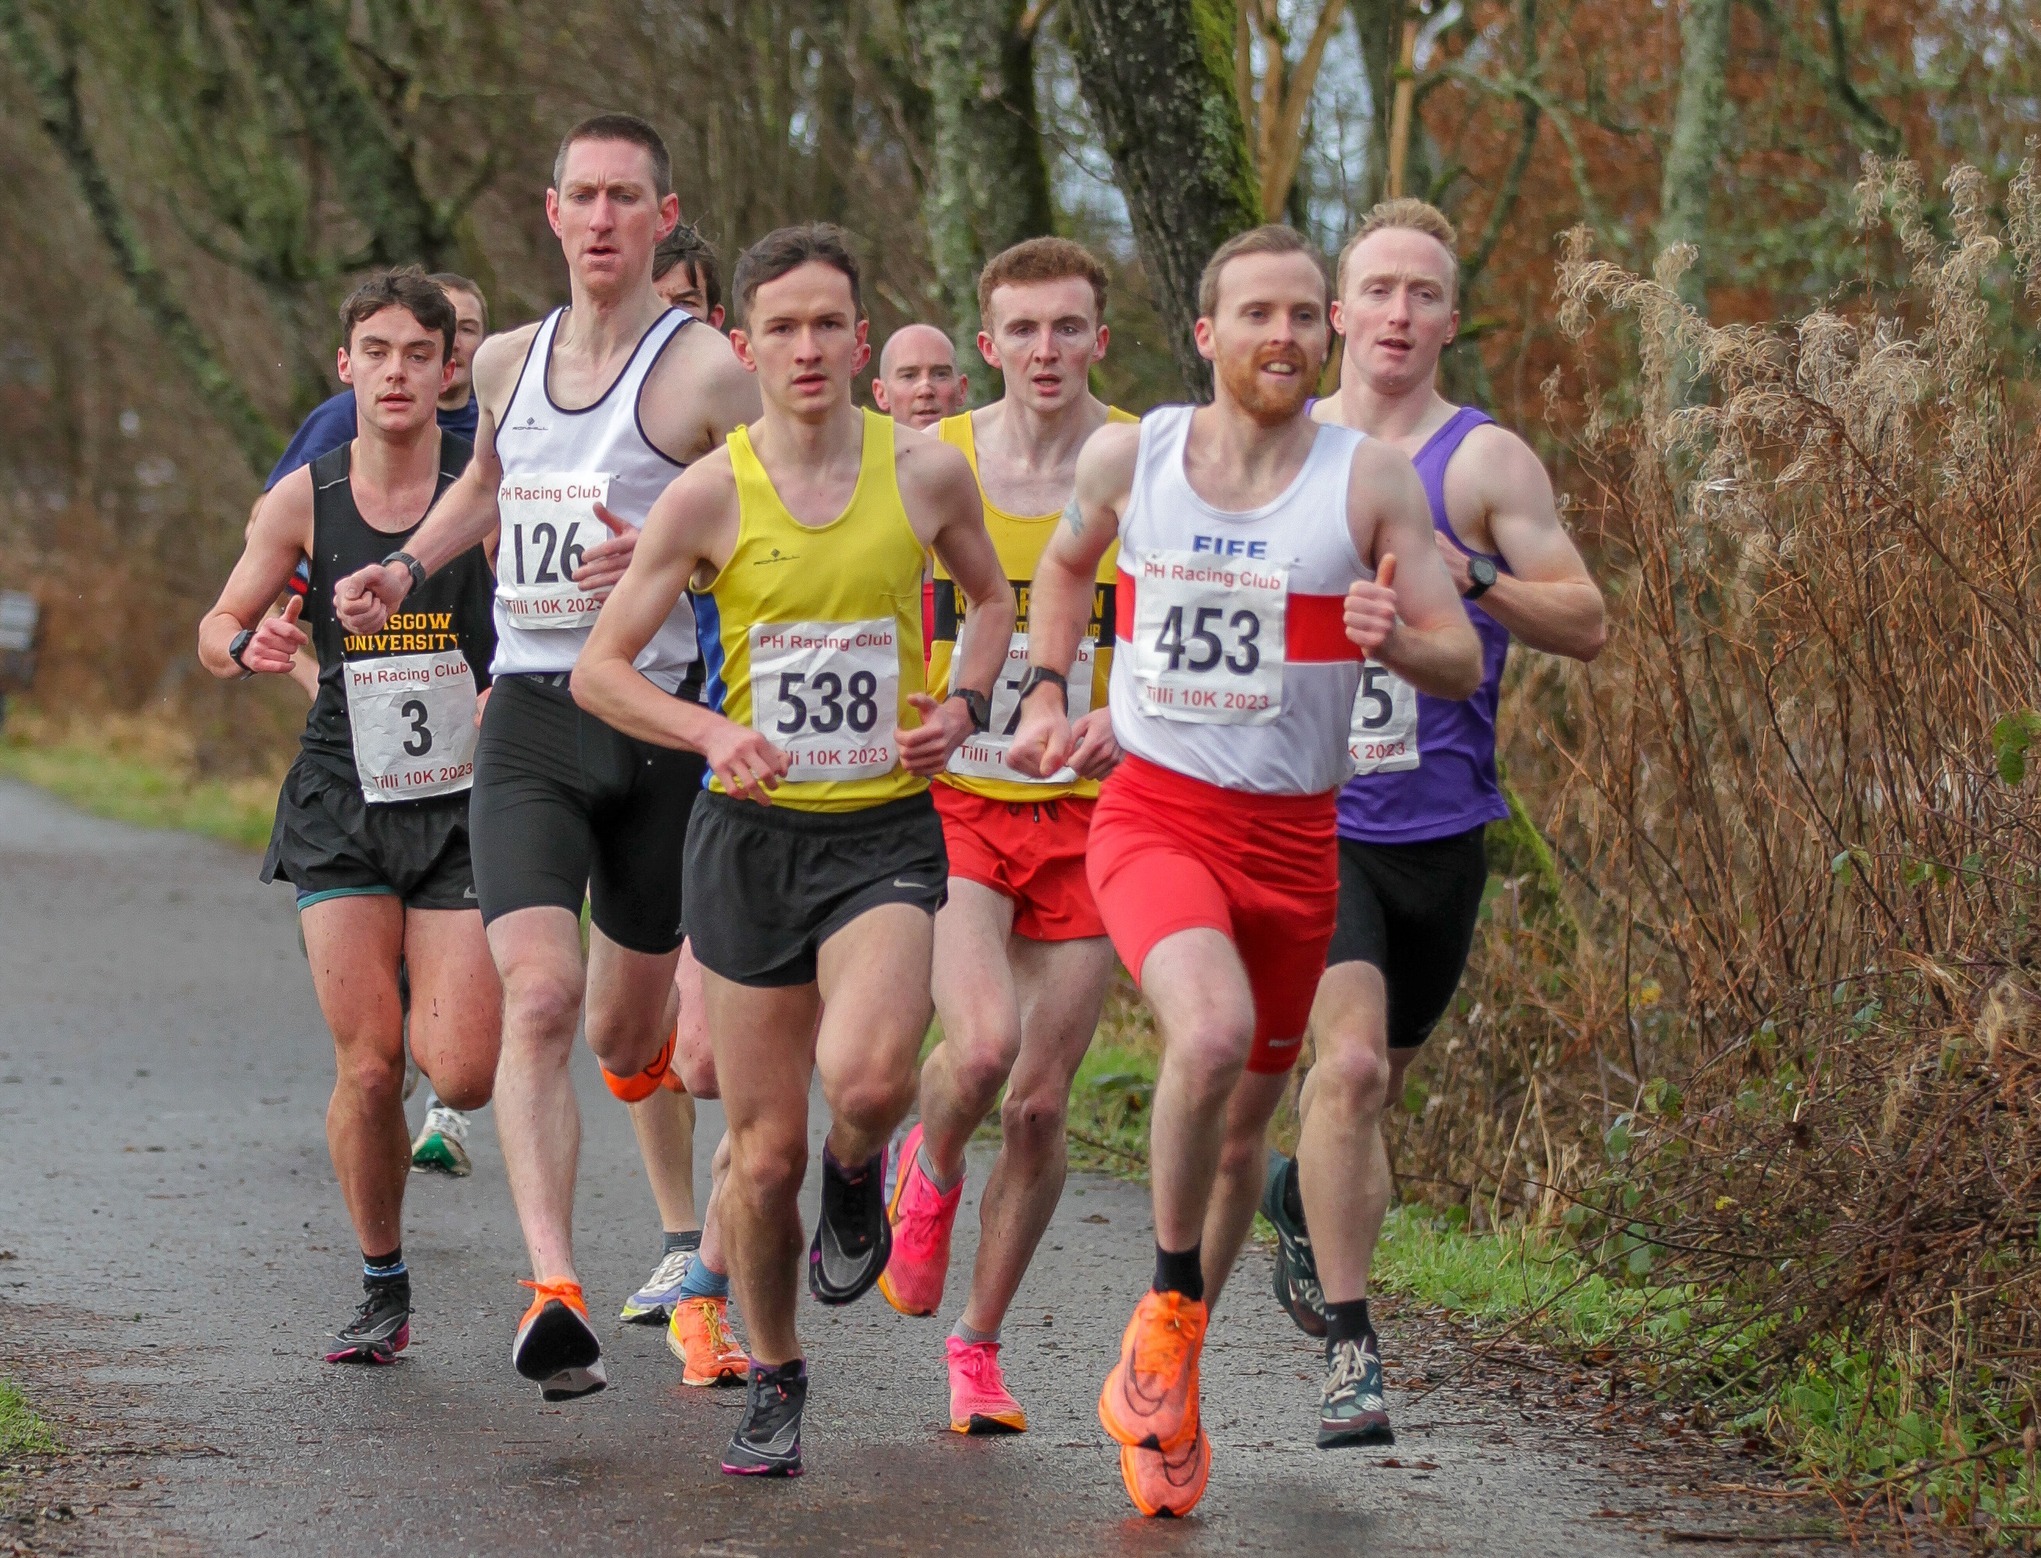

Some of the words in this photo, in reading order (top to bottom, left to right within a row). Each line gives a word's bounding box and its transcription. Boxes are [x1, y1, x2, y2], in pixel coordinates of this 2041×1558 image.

[501, 487, 512, 501] PH
[514, 486, 562, 502] Racing
[566, 485, 601, 499] Club
[513, 521, 585, 585] 126
[1192, 535, 1268, 560] FIFE
[1144, 561, 1166, 579] PH
[1171, 565, 1235, 588] Racing
[1239, 571, 1281, 590] Club
[532, 599, 562, 615] 10K
[384, 612, 453, 631] SGOW
[344, 633, 459, 652] UNIVERSITY
[760, 635, 784, 649] PH
[790, 635, 850, 651] Racing
[855, 632, 893, 647] Club
[1154, 605, 1260, 676] 453
[353, 673, 373, 686] PH
[378, 668, 430, 683] Racing
[435, 661, 468, 678] Club
[776, 670, 878, 734] 538
[1180, 690, 1217, 708] 10K
[1223, 692, 1269, 710] 2023
[401, 699, 433, 757] 3
[806, 749, 841, 766] 10K
[847, 747, 888, 765] 2023
[960, 745, 989, 763] Tilli
[1365, 742, 1405, 760] 2023
[372, 773, 399, 789] Tilli
[404, 769, 435, 786] 10K
[440, 762, 473, 782] 2023
